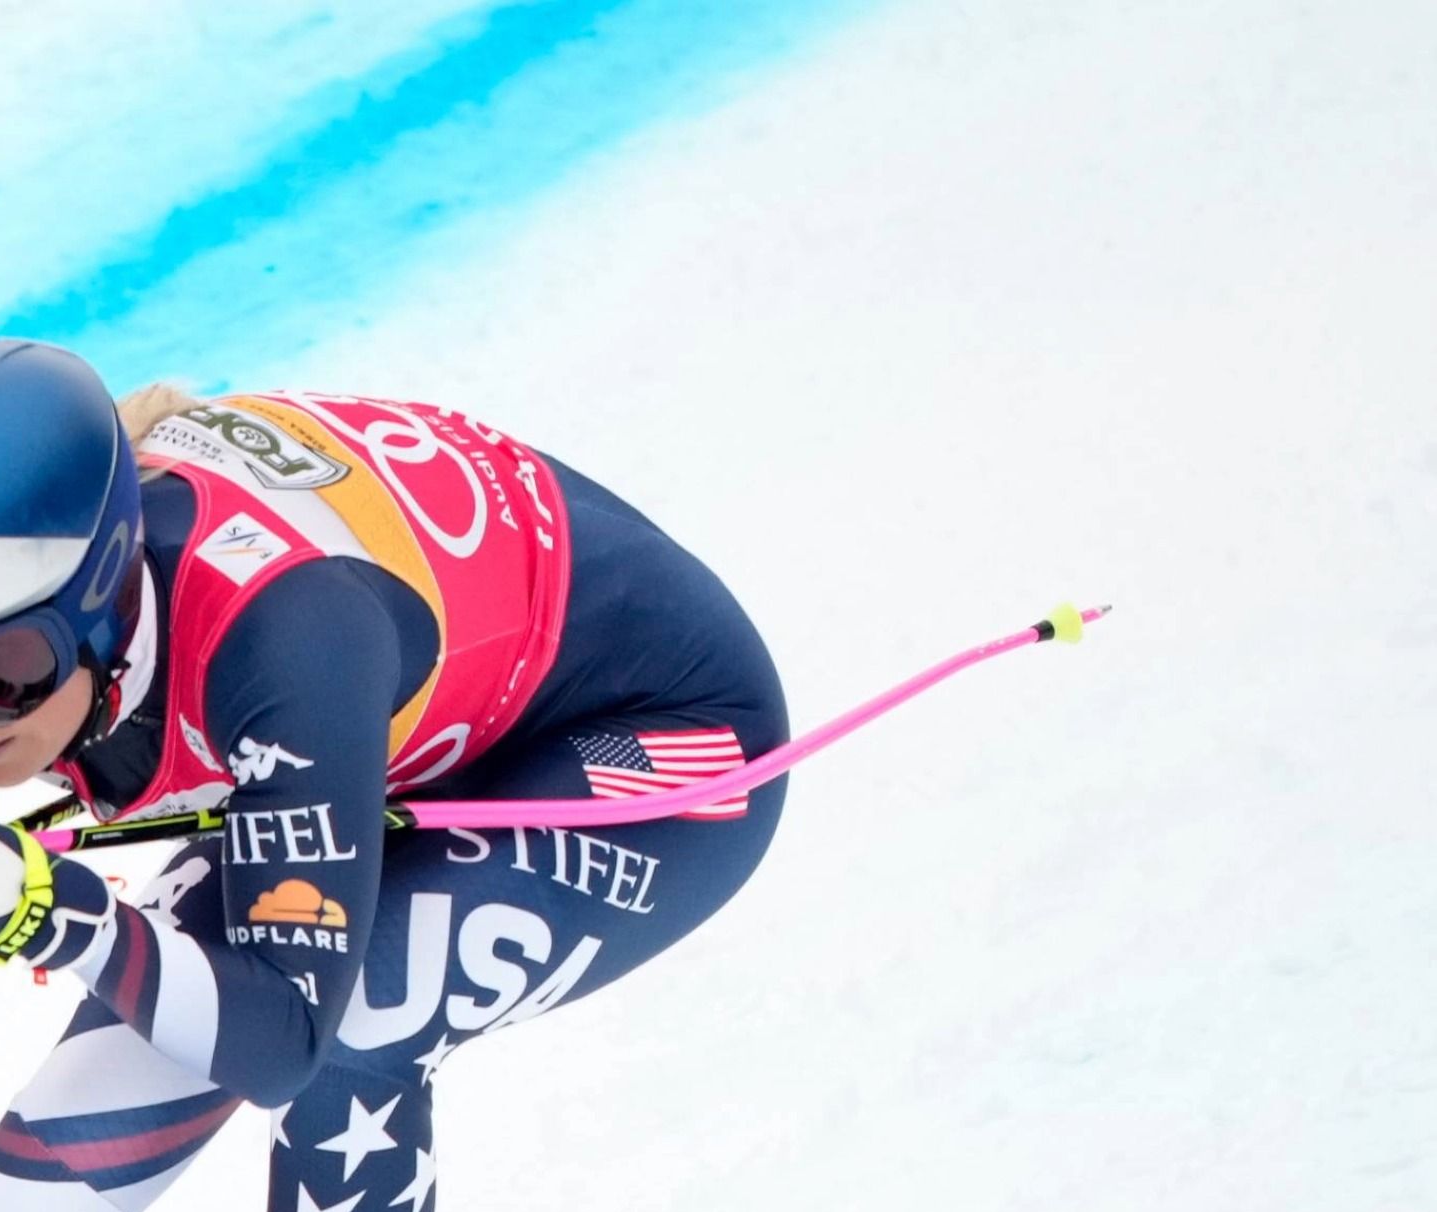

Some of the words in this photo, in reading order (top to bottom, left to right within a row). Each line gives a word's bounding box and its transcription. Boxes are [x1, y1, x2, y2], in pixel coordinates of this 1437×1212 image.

[179, 405, 317, 477] FOR
[470, 451, 519, 531] Audi
[224, 803, 357, 864] IFEL
[226, 925, 348, 953] UDFLARE
[336, 892, 603, 1051] USA
